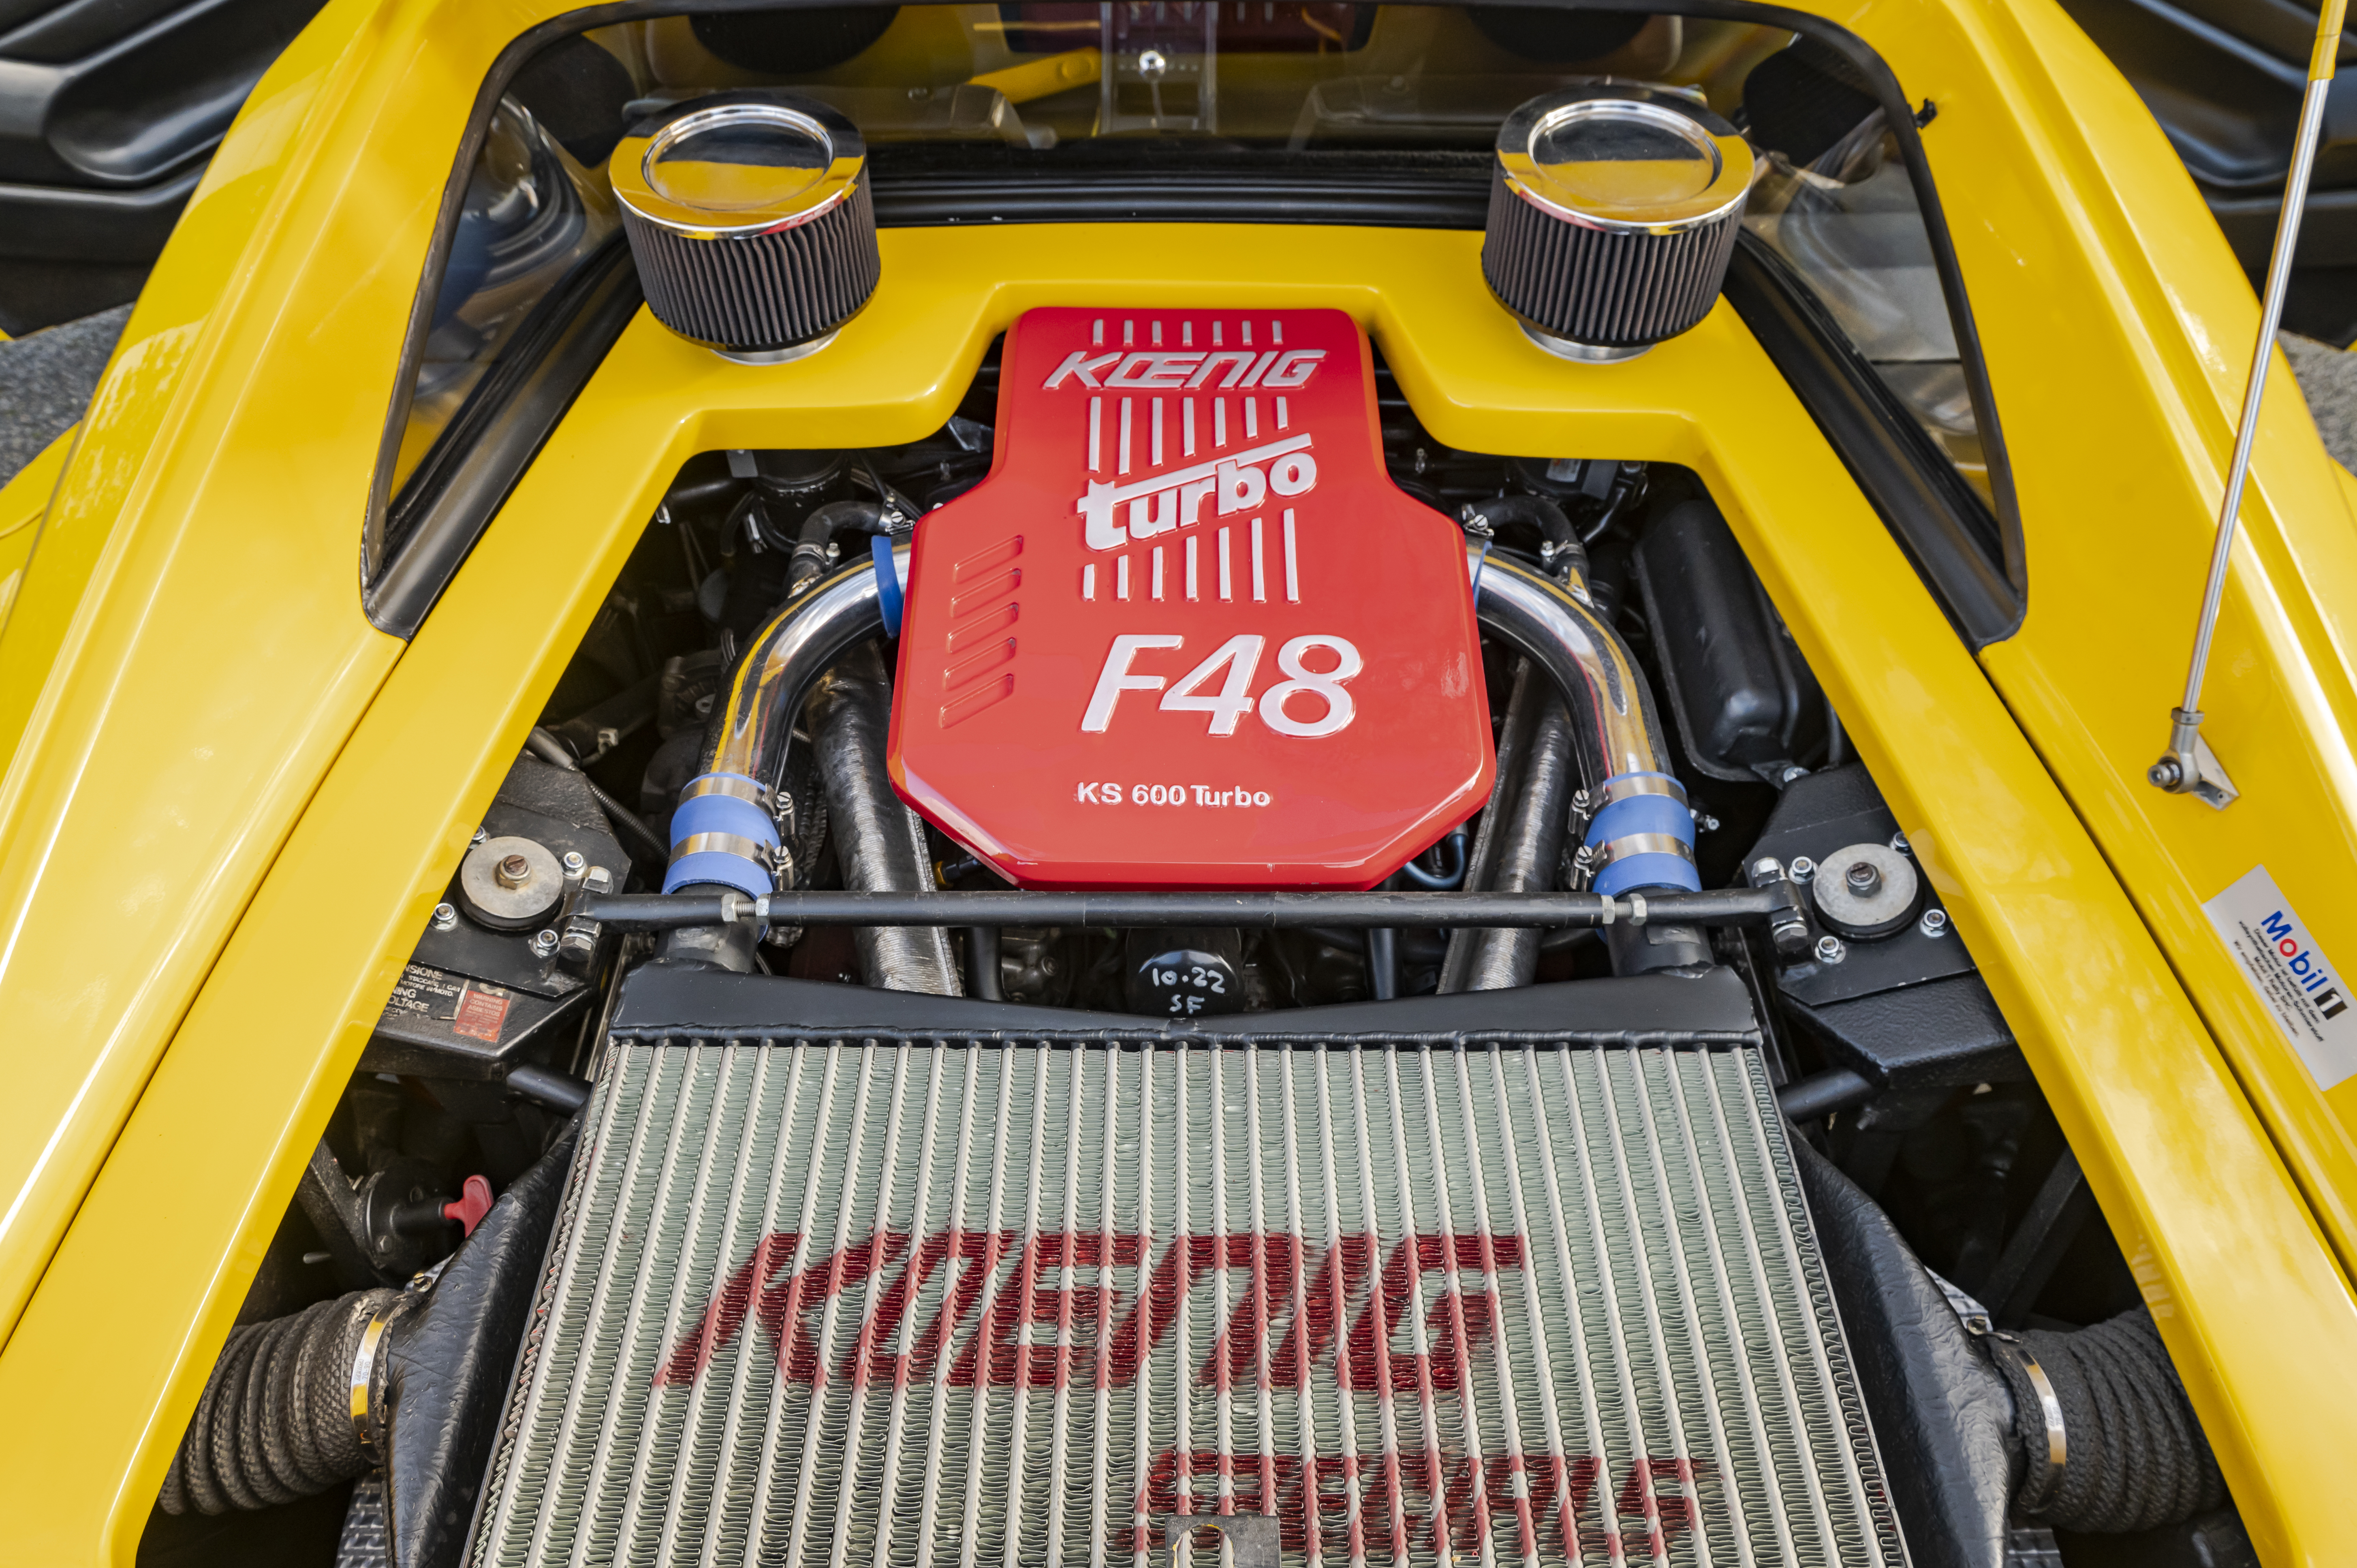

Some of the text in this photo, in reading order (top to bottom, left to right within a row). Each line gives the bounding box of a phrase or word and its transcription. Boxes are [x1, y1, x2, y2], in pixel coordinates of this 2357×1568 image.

[1076, 432, 1317, 551] turbo
[1079, 634, 1363, 739] F48
[1075, 782, 1271, 808] KS 600 Turbo
[2261, 910, 2329, 992] Mobil
